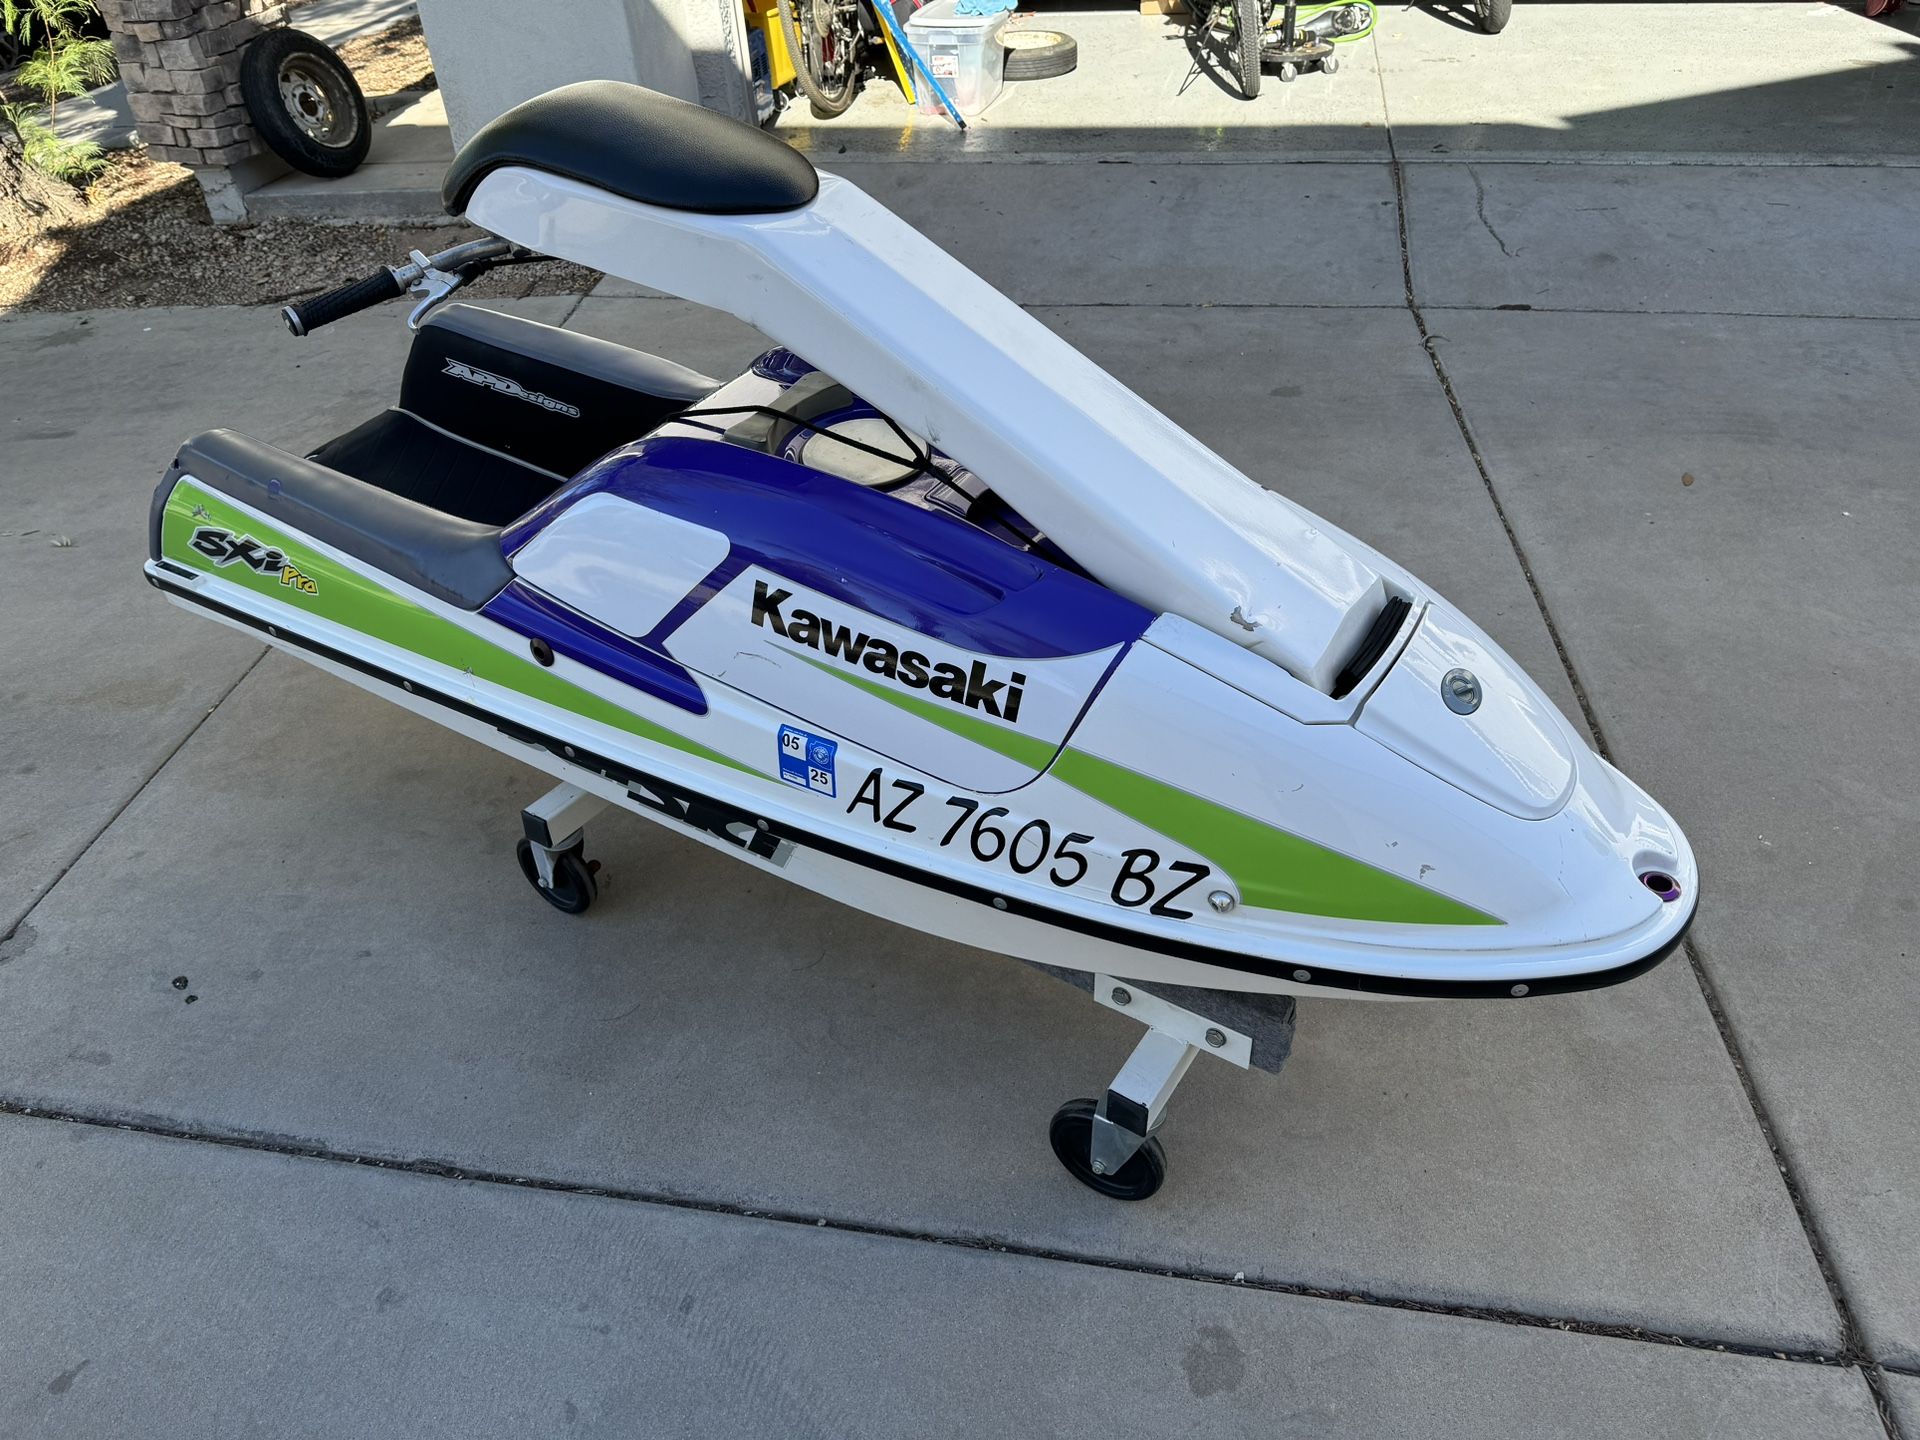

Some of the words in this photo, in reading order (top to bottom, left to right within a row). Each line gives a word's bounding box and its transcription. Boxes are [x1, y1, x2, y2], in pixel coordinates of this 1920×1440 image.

[751, 579, 1027, 723] Kawasaki
[782, 733, 800, 750] 05
[810, 768, 829, 785] 25
[846, 767, 925, 834] AZ
[939, 795, 1095, 888] 7605
[1110, 848, 1211, 921] BZ
